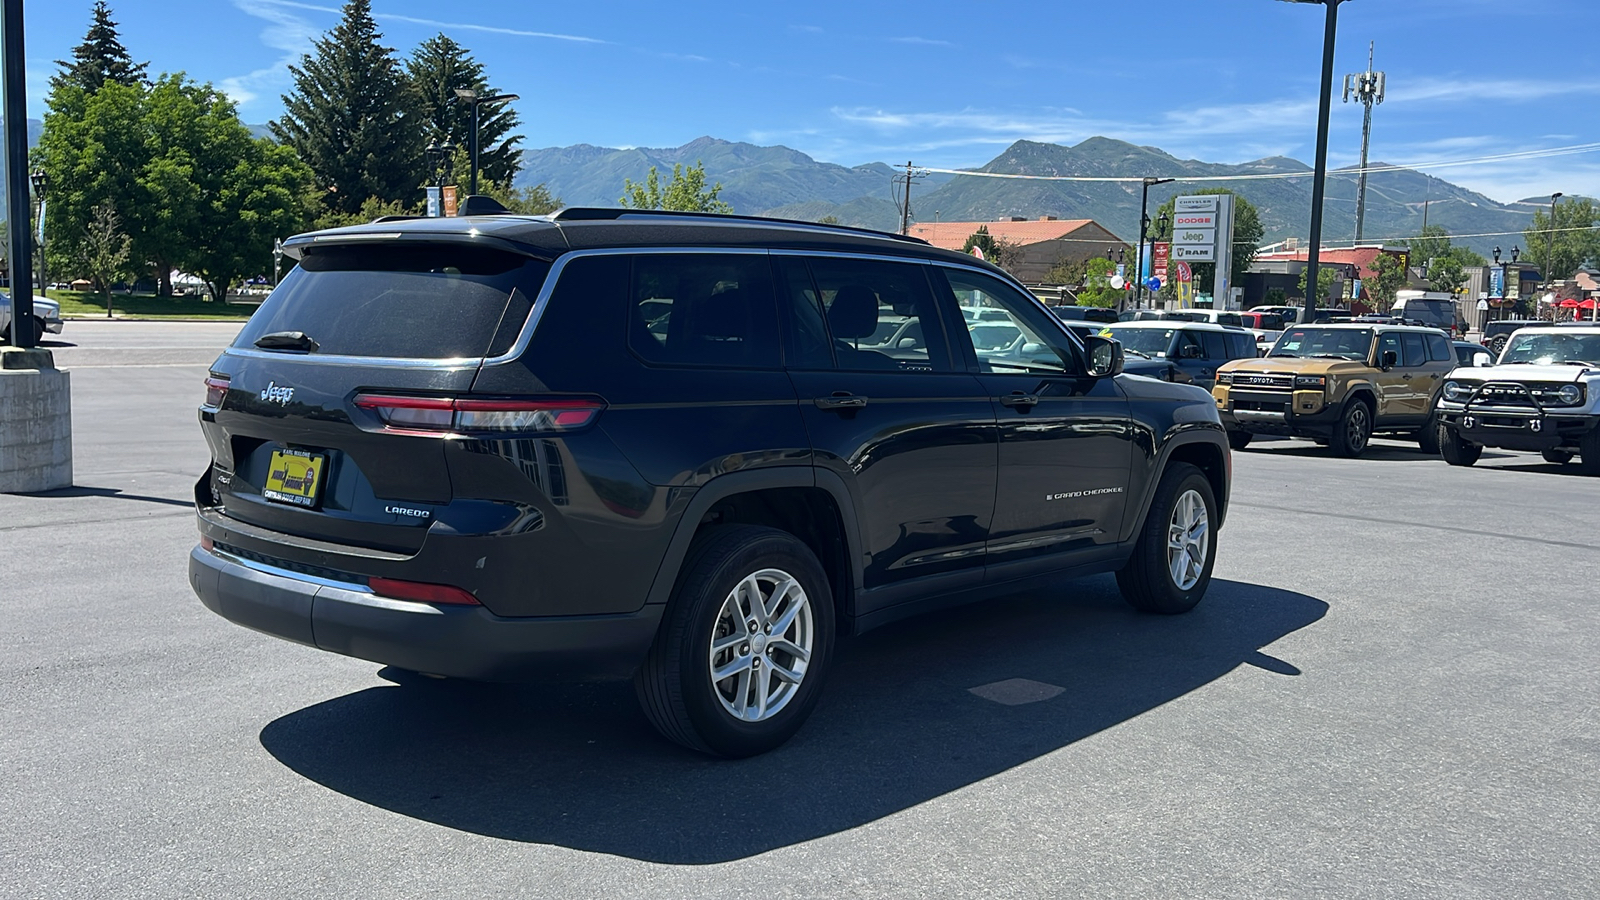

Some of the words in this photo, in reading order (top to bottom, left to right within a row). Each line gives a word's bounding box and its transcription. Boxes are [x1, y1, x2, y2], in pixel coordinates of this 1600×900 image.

[1182, 231, 1204, 242] Jeep
[261, 381, 295, 407] Jeep
[1054, 491, 1082, 499] GRAND
[1083, 487, 1123, 496] CHEROKEE
[385, 506, 430, 518] LAREDO
